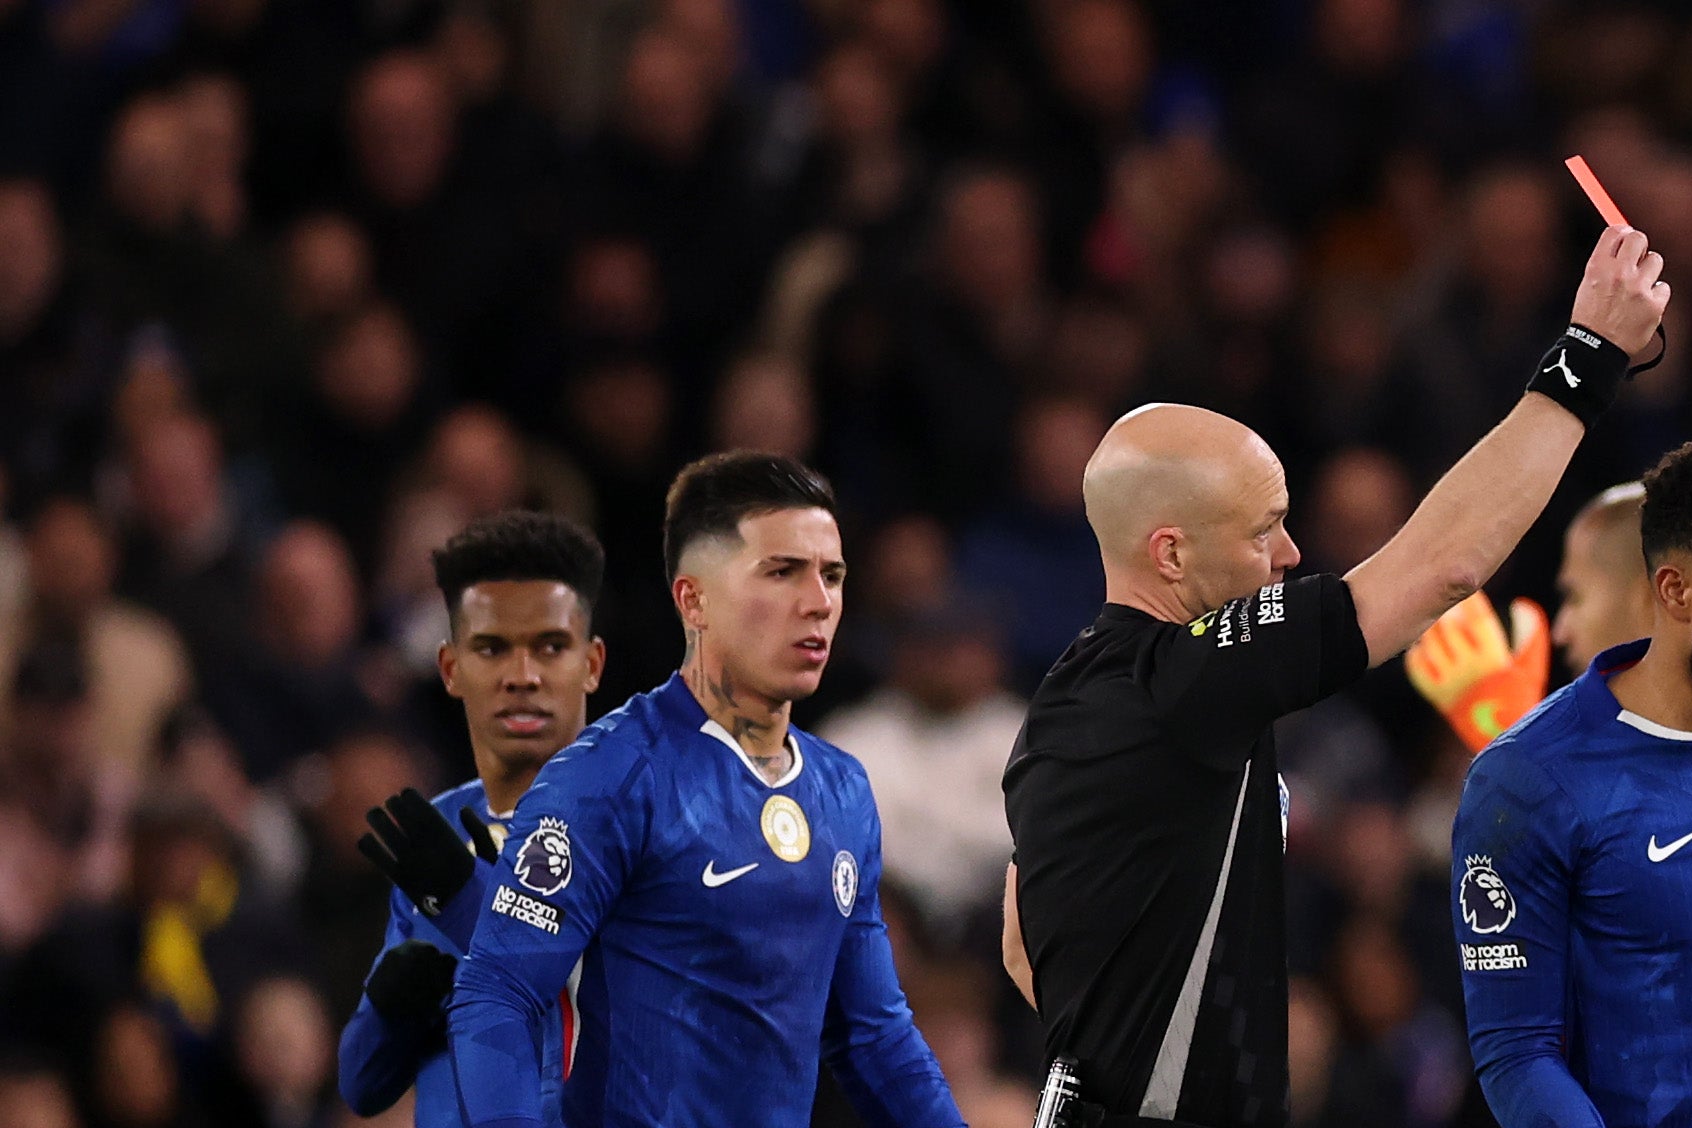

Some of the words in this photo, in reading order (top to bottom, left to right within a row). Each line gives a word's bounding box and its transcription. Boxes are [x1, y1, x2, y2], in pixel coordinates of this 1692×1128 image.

[1257, 602, 1272, 625] No
[497, 884, 517, 902] No
[516, 894, 558, 921] room
[510, 905, 560, 935] racism
[1460, 943, 1477, 959] No
[1478, 943, 1519, 959] room
[1478, 956, 1528, 971] racism
